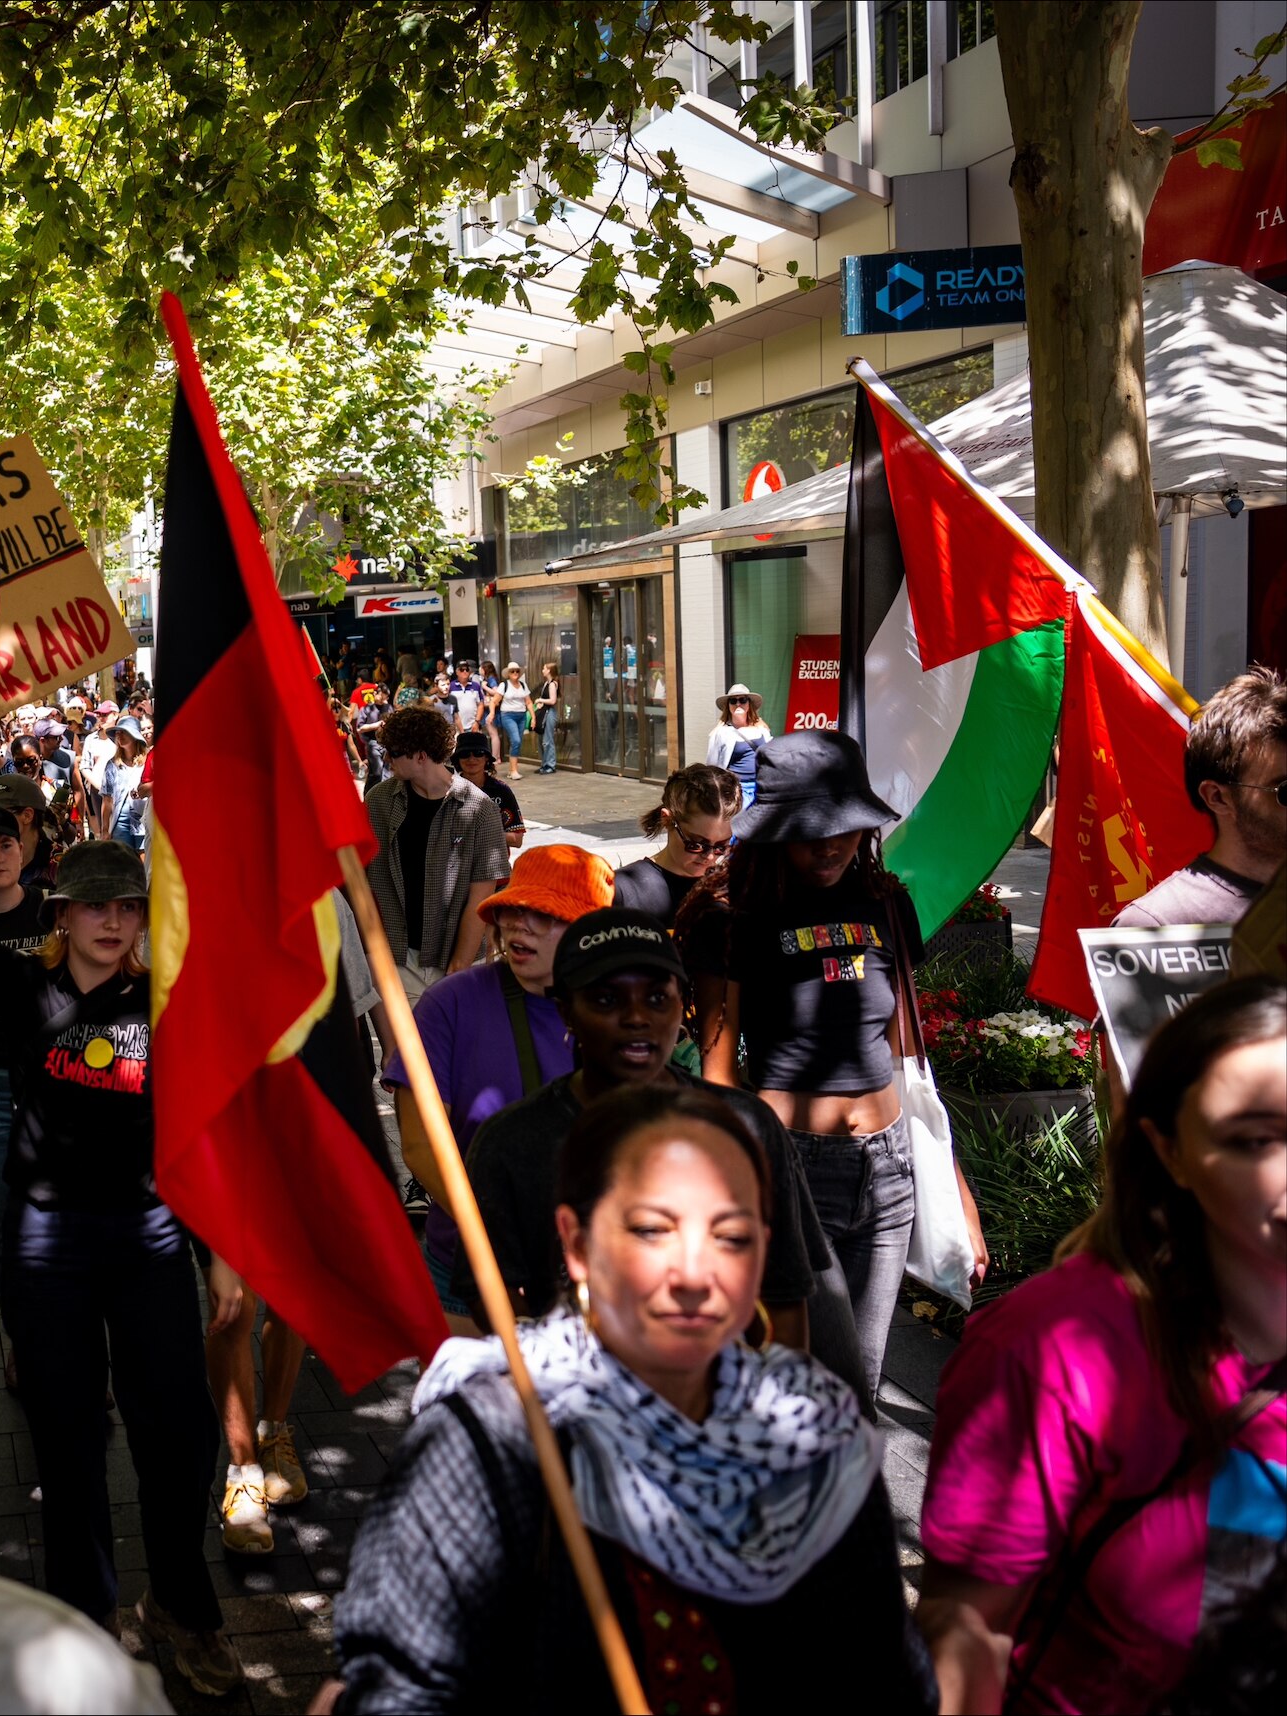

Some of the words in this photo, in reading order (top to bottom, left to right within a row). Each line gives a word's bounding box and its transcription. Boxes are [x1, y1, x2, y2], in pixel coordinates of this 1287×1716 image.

[936, 291, 990, 307] TEAM
[995, 288, 1026, 302] ON
[34, 507, 80, 554] BE
[362, 552, 405, 575] nab
[290, 601, 311, 612] nab
[361, 596, 440, 614] Kmart
[14, 597, 111, 684] LAND
[579, 926, 628, 951] Calvin
[627, 925, 663, 944] Klein
[780, 922, 882, 954] SURVIVAL
[822, 954, 865, 982] DAY
[1093, 945, 1232, 978] SOVEREI
[113, 1023, 150, 1060] WAS
